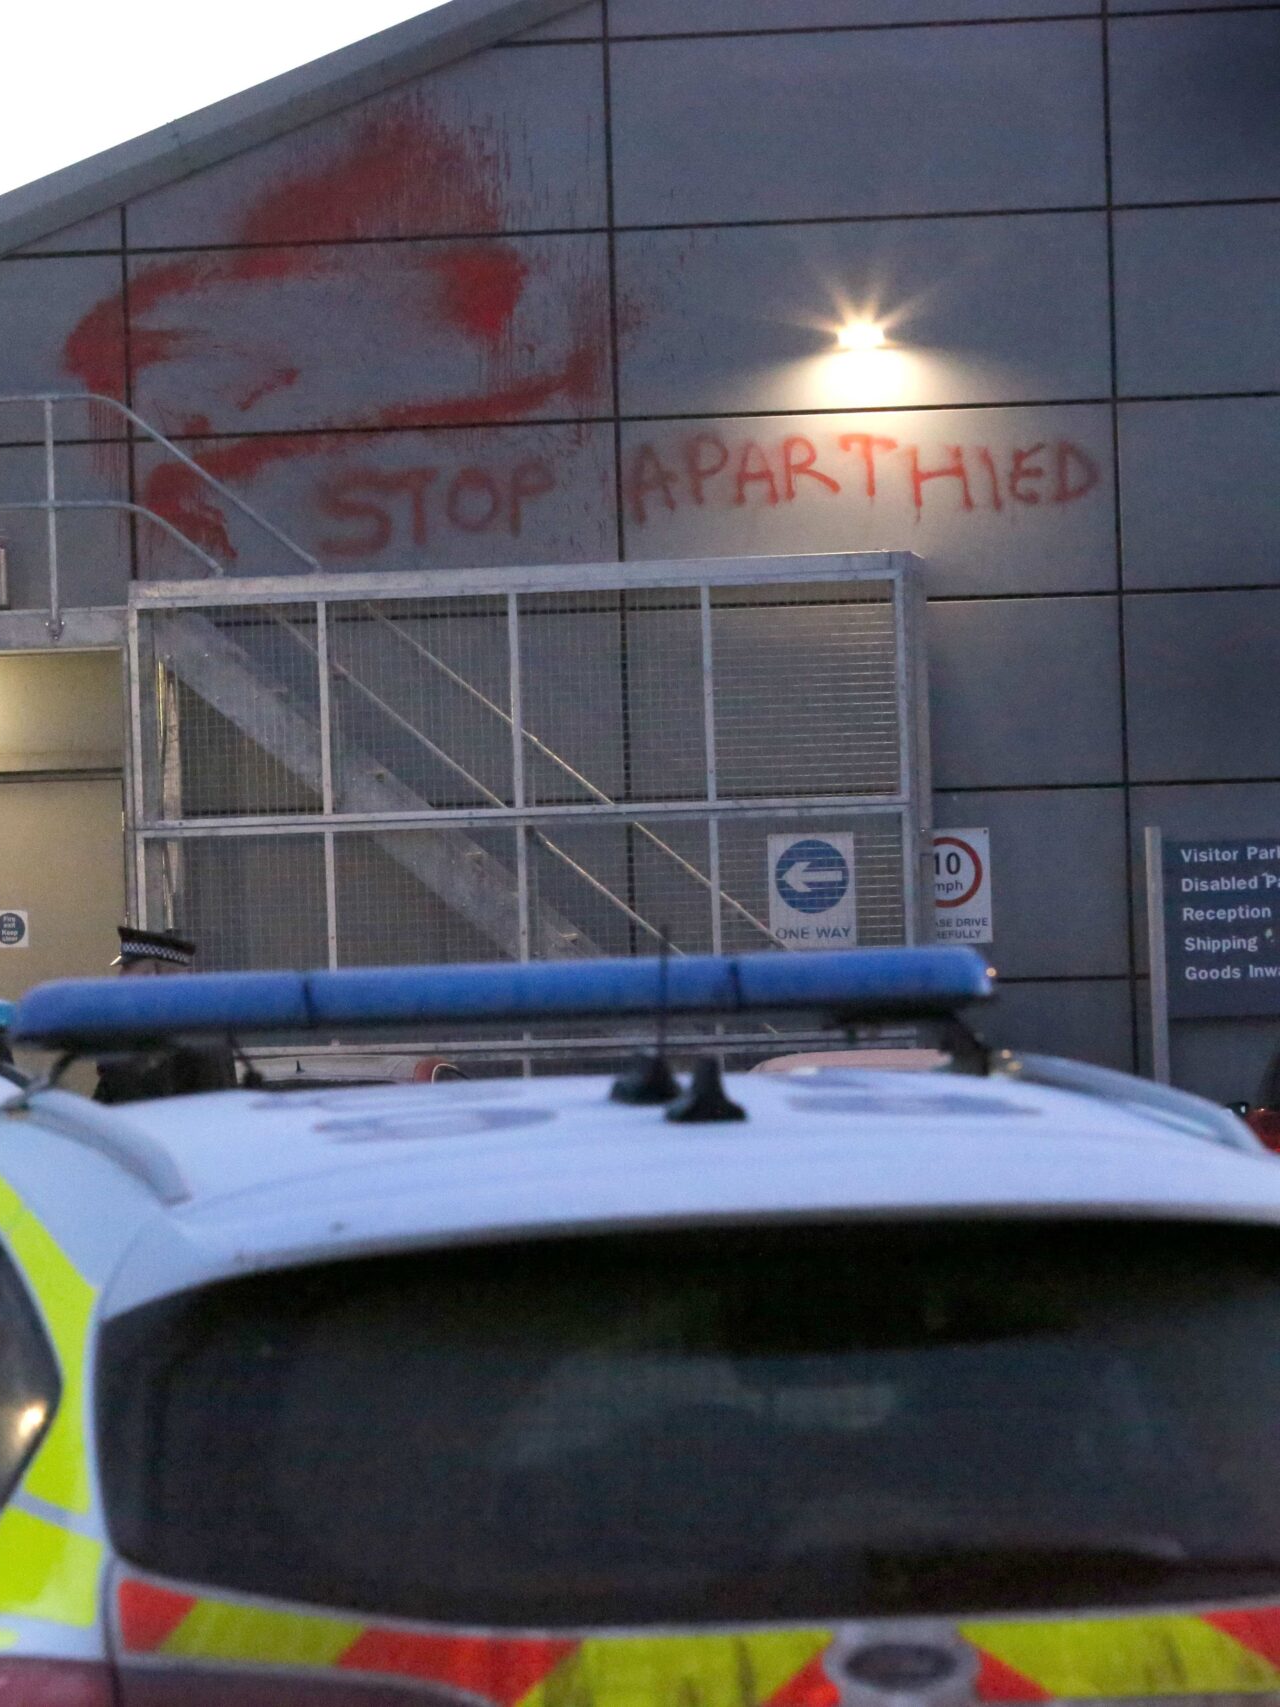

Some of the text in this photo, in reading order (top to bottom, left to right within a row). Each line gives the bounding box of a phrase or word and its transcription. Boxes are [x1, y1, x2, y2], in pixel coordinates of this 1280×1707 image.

[316, 433, 1101, 557] STOP APARTHIED
[1180, 848, 1239, 862] Visitor
[934, 852, 961, 875] 10
[934, 880, 963, 893] mph
[1181, 875, 1259, 892] Disabled
[1182, 904, 1272, 922] Reception
[956, 917, 988, 927] DRIVE
[775, 925, 850, 940] ONE WAY
[1184, 936, 1259, 953] Shipping
[1185, 964, 1280, 980] Goods Inw
